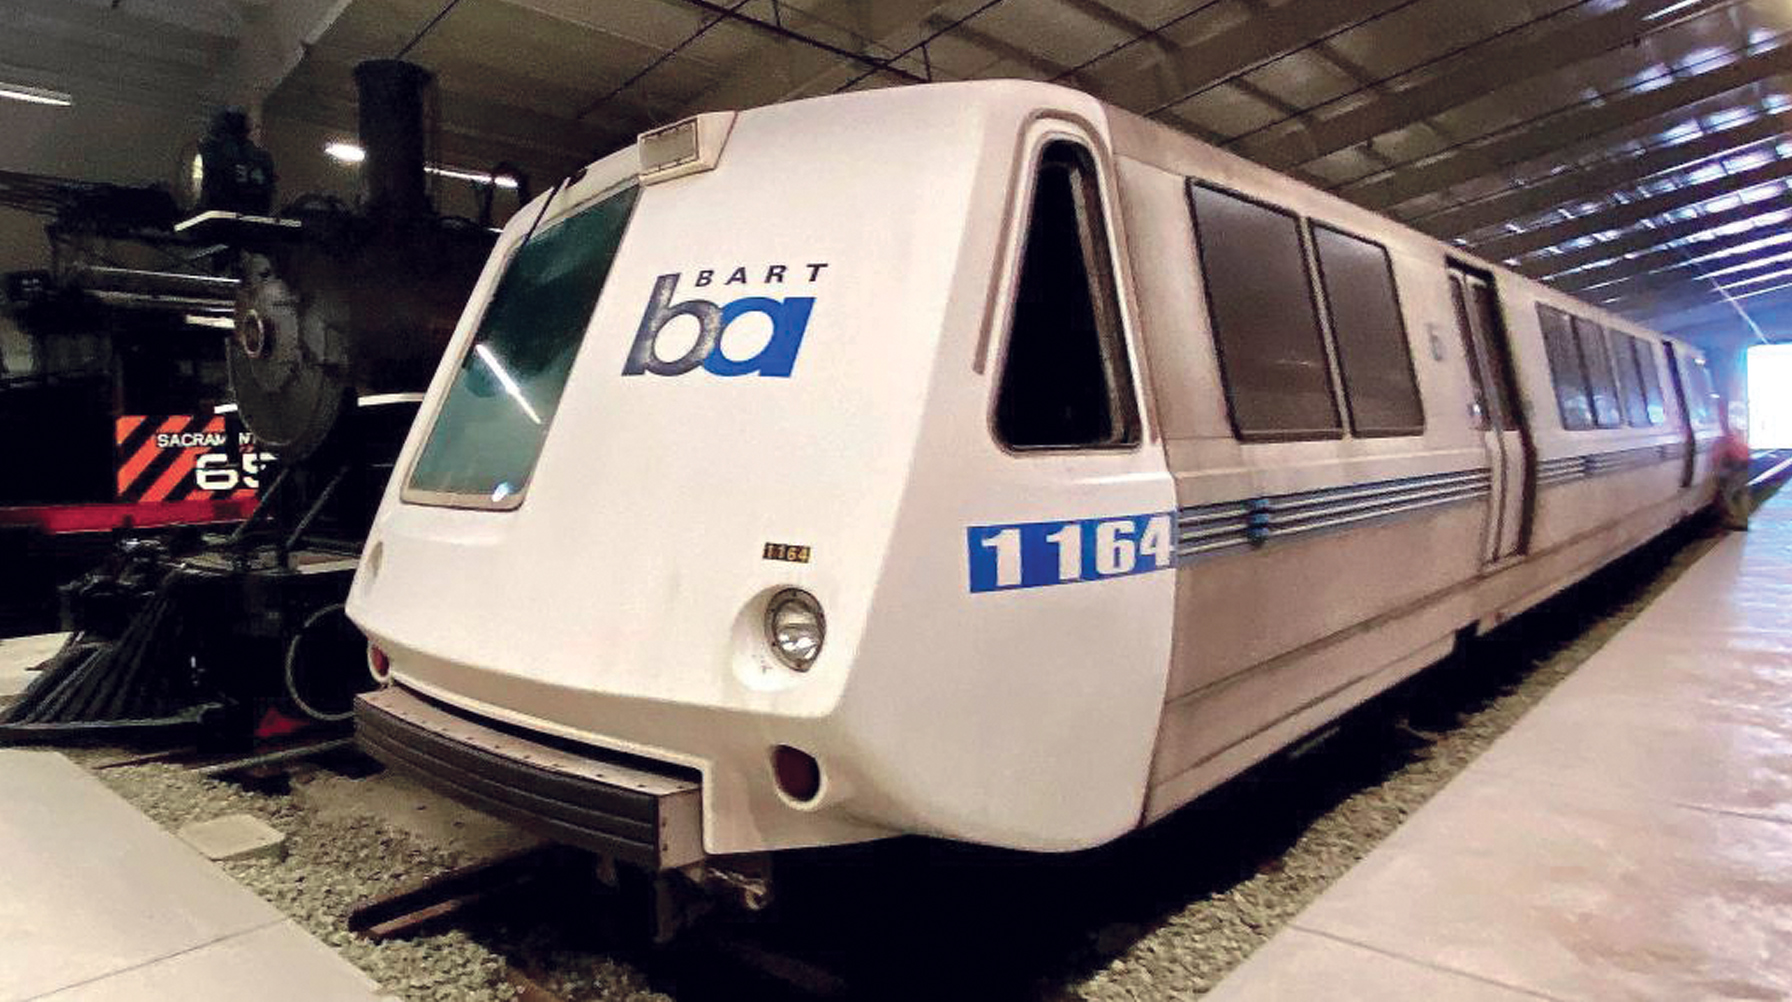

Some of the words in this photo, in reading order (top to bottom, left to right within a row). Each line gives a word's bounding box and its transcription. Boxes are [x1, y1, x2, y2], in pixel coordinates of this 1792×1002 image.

[695, 263, 828, 287] BART
[621, 272, 816, 377] ba
[981, 514, 1175, 586] 1164
